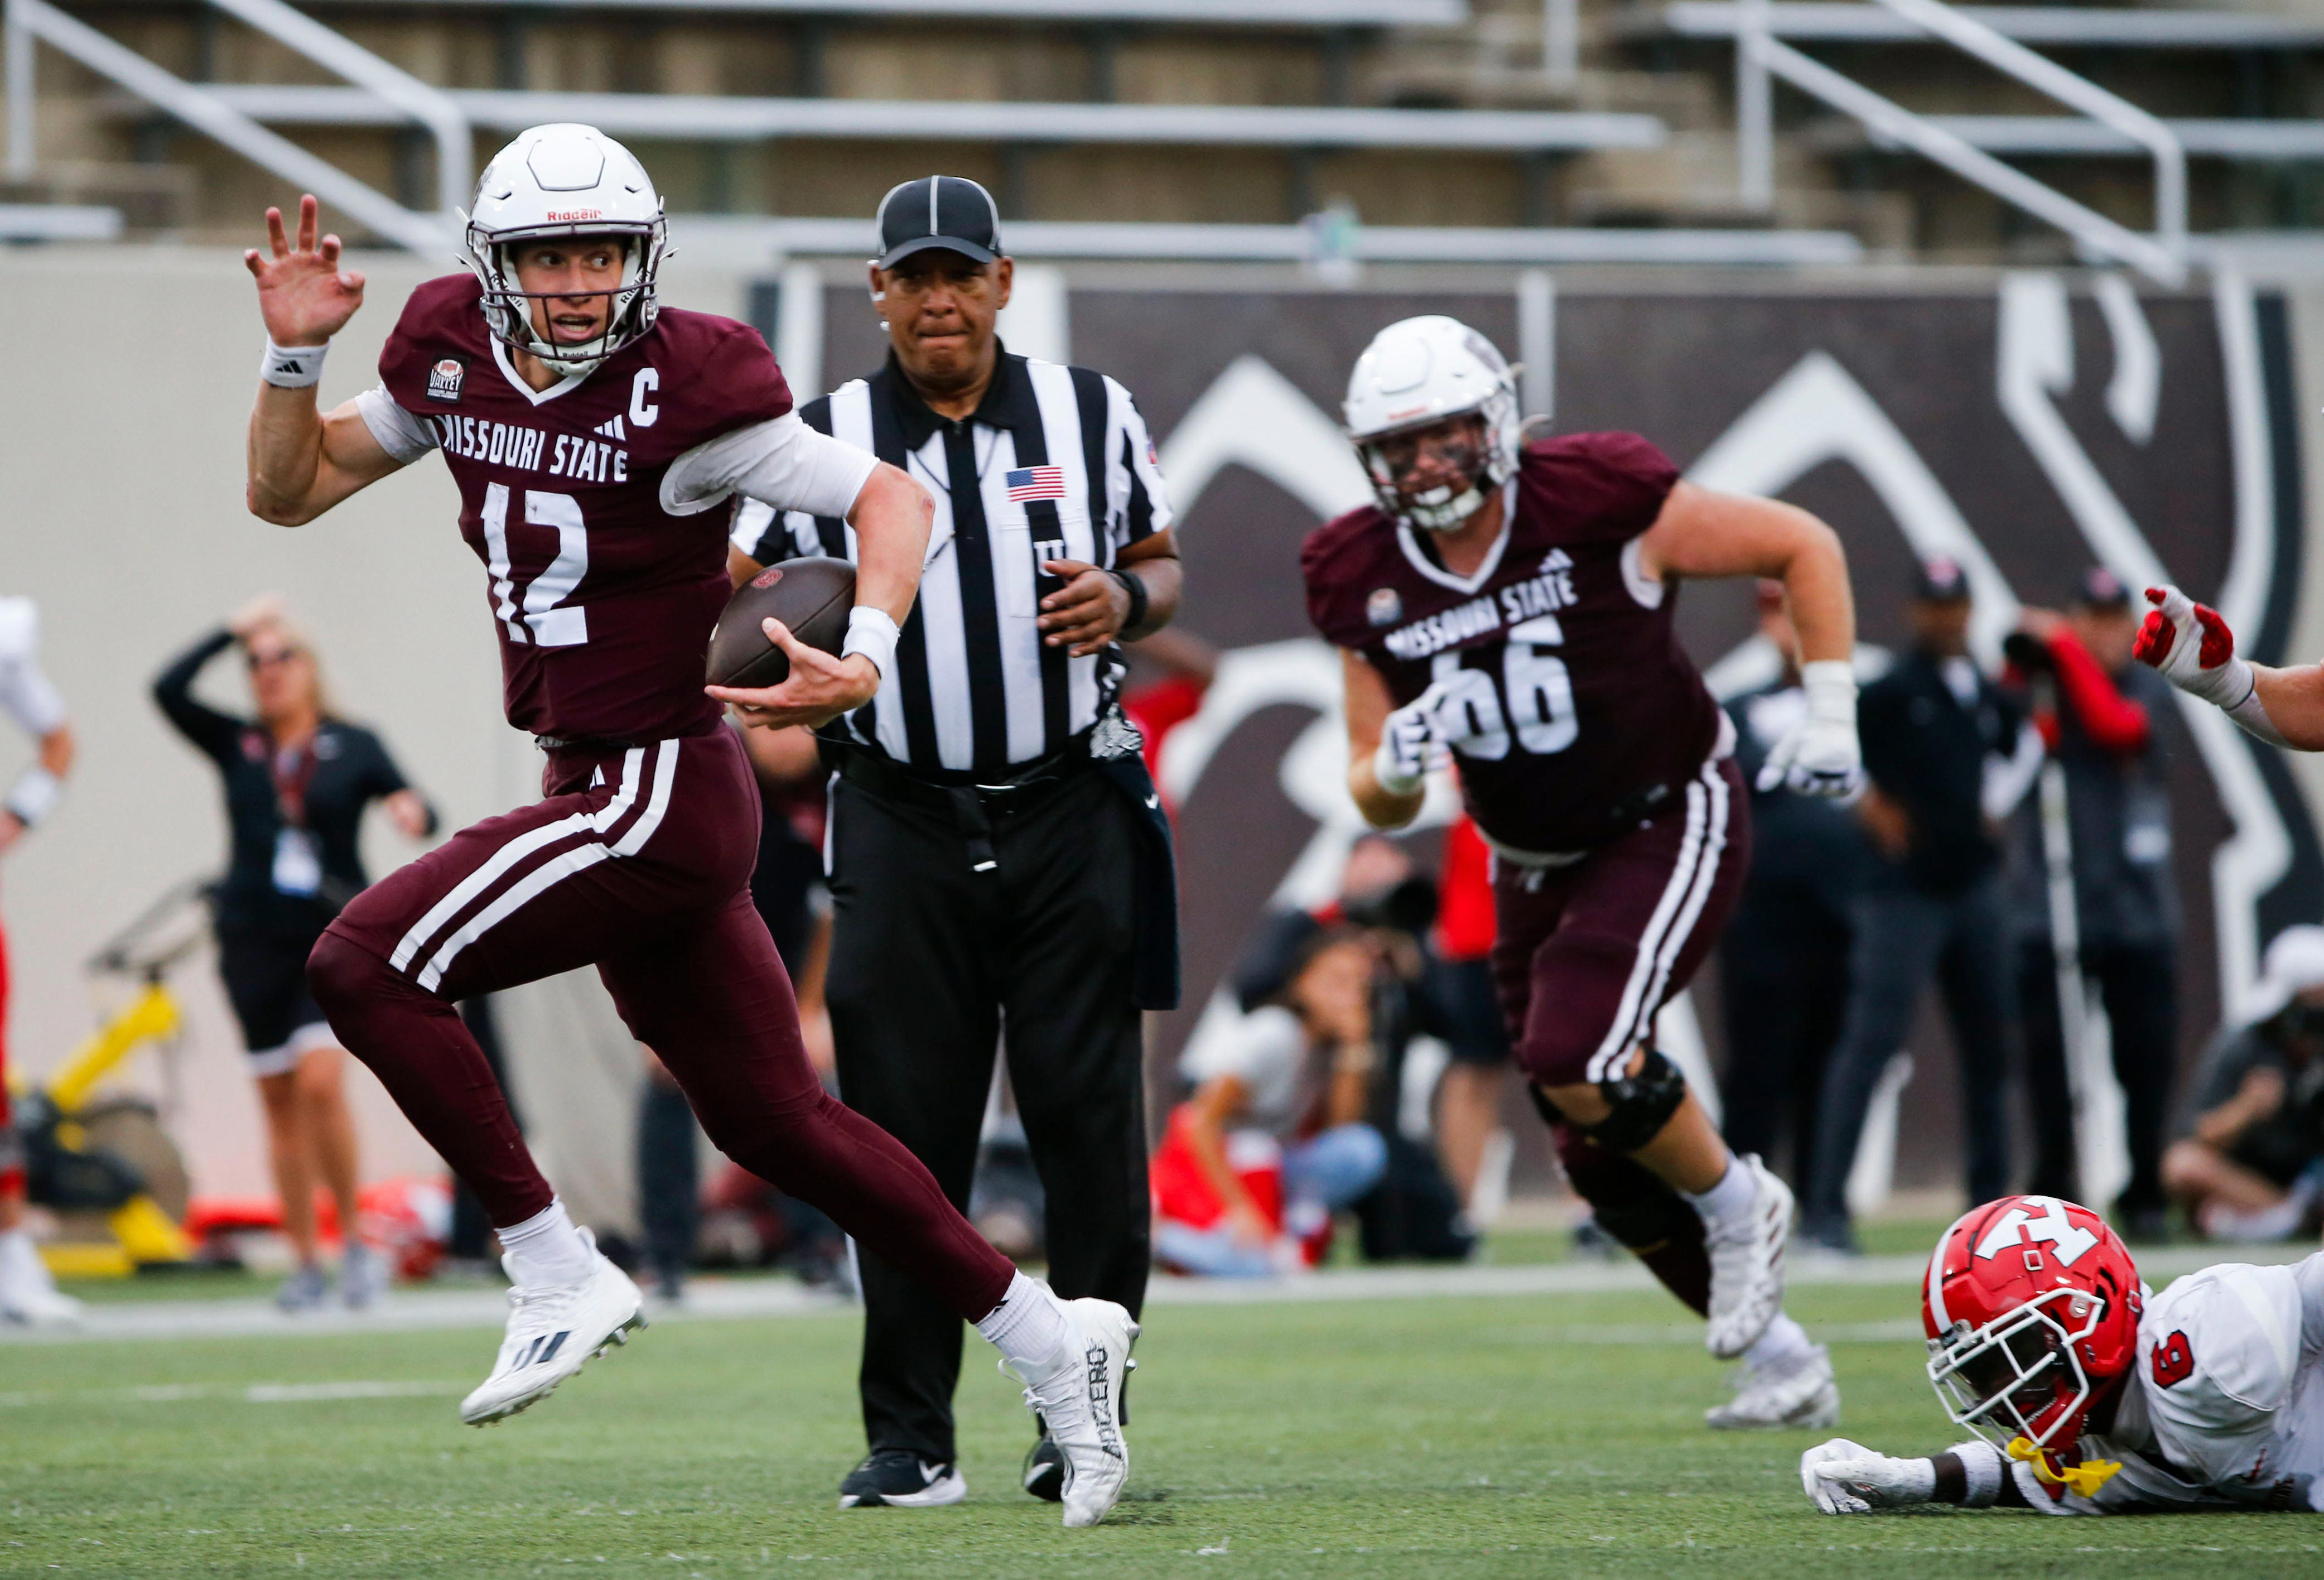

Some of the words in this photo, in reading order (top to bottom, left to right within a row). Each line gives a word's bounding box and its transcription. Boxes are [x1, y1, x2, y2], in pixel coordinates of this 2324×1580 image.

[547, 209, 597, 221] Riddell
[430, 368, 463, 392] VALLEY
[629, 367, 659, 427] C
[549, 434, 628, 483] STATE
[480, 481, 589, 648] 12
[1501, 570, 1578, 623] STATE
[1431, 614, 1579, 761] 66
